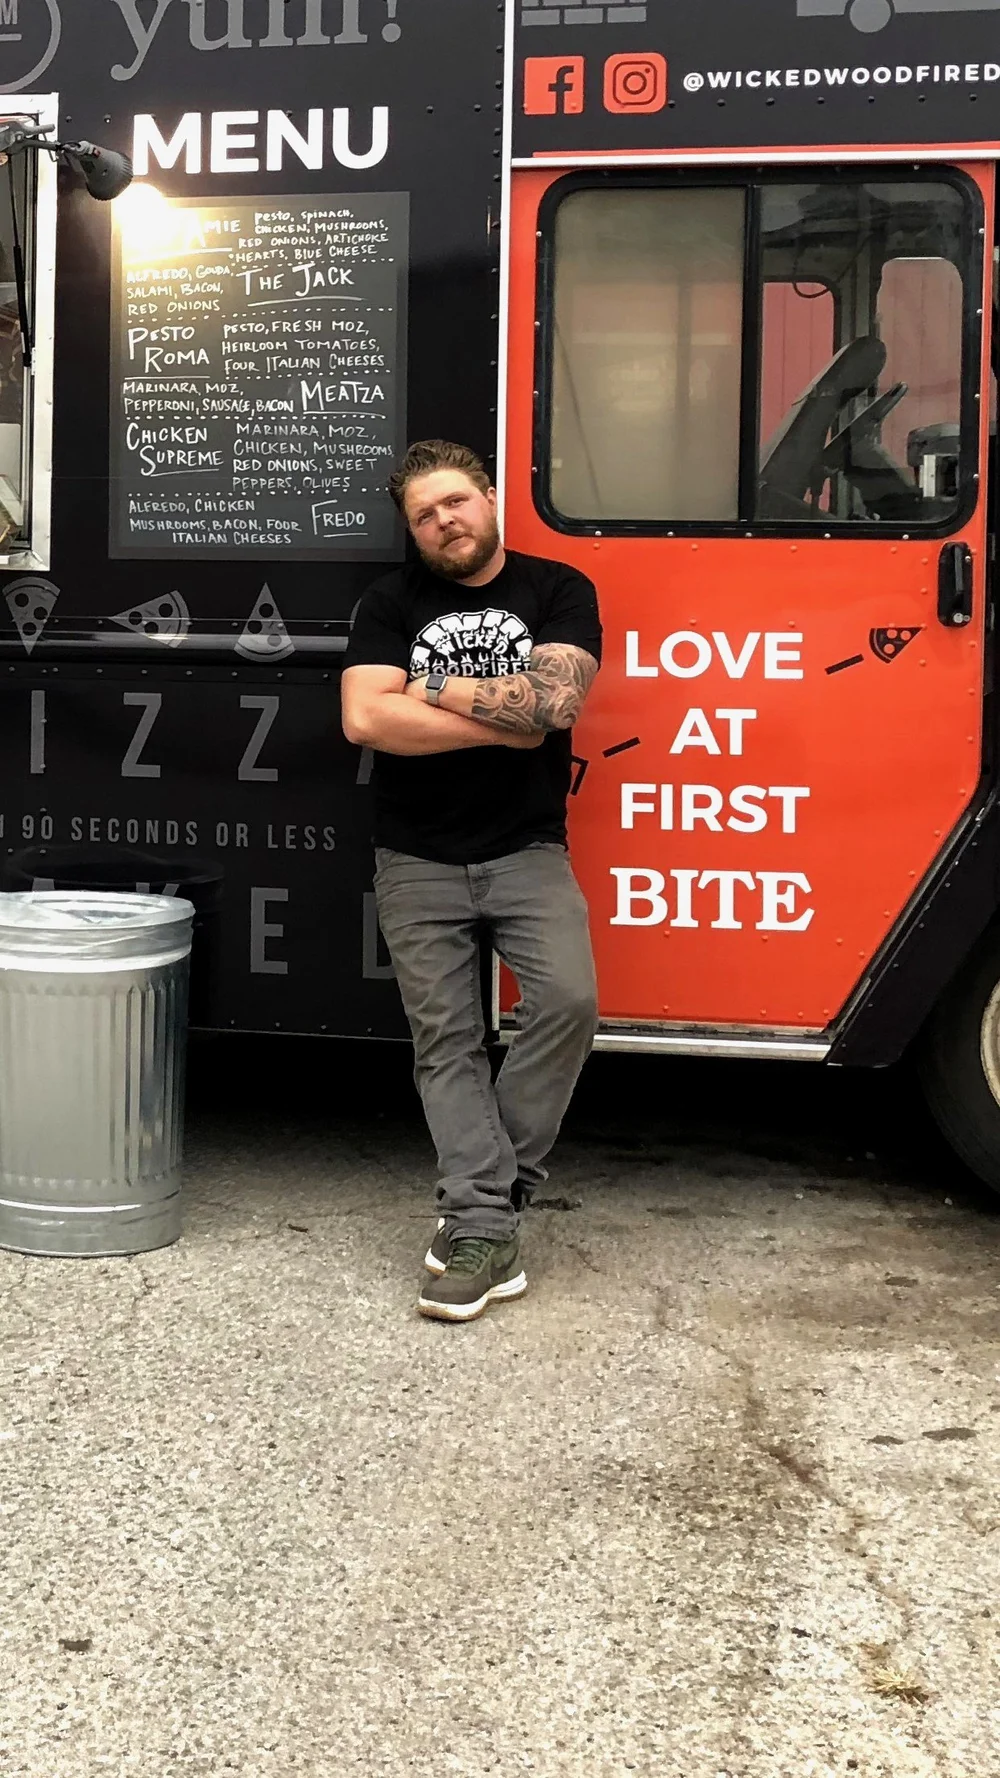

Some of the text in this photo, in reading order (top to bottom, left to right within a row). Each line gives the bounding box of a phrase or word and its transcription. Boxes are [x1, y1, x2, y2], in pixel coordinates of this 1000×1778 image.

[683, 63, 1000, 92] @WICKEDWOODFIRED
[132, 106, 389, 176] MENU
[315, 220, 389, 233] MUSHROOMS,
[238, 233, 389, 249] RED ONIONS, ARTICHOKE
[236, 245, 378, 263] HEARTS, BLUE CHEESE
[126, 268, 192, 283] ALFREDO,
[236, 261, 355, 297] THE JACK
[127, 282, 224, 299] SALAMI, BACON,
[127, 300, 221, 316] RED ONIONS
[271, 320, 322, 333] FRESH
[331, 320, 370, 336] MOZ,
[128, 326, 195, 360] PESTO
[221, 338, 380, 356] HEIRLOOM TOMATOES,
[145, 347, 210, 374] ROMA
[224, 353, 385, 375] FOUR ITALIAN CHEESES
[122, 382, 244, 396] MARINARA, MOZ,
[301, 380, 385, 411] MEATZA
[123, 397, 294, 417] PEPPERONI, SAUSAGE, BACON
[126, 422, 208, 451] CHICKEN
[236, 423, 377, 440] MARINARA, MOZ,
[233, 439, 308, 457] CHICKEN,
[140, 445, 224, 476] SUPREME
[233, 458, 378, 474] RED ONIONS, SWEET
[232, 476, 351, 491] PEPPERS, OLIVES
[129, 499, 256, 514] ALFREDO, CHICKEN
[129, 518, 302, 532] MUSHROOMS, BACON, FOUR
[311, 500, 365, 535] FREDO
[173, 532, 292, 545] ITALIAN CHEESES
[434, 629, 510, 657] WICKED
[625, 630, 804, 680] LOVE
[669, 708, 757, 756] AT
[621, 783, 811, 834] FIRST
[22, 814, 53, 840] 90
[71, 816, 198, 845] SECONDS
[216, 822, 249, 848] OR
[267, 824, 336, 851] LESS
[609, 867, 815, 932] BITE
